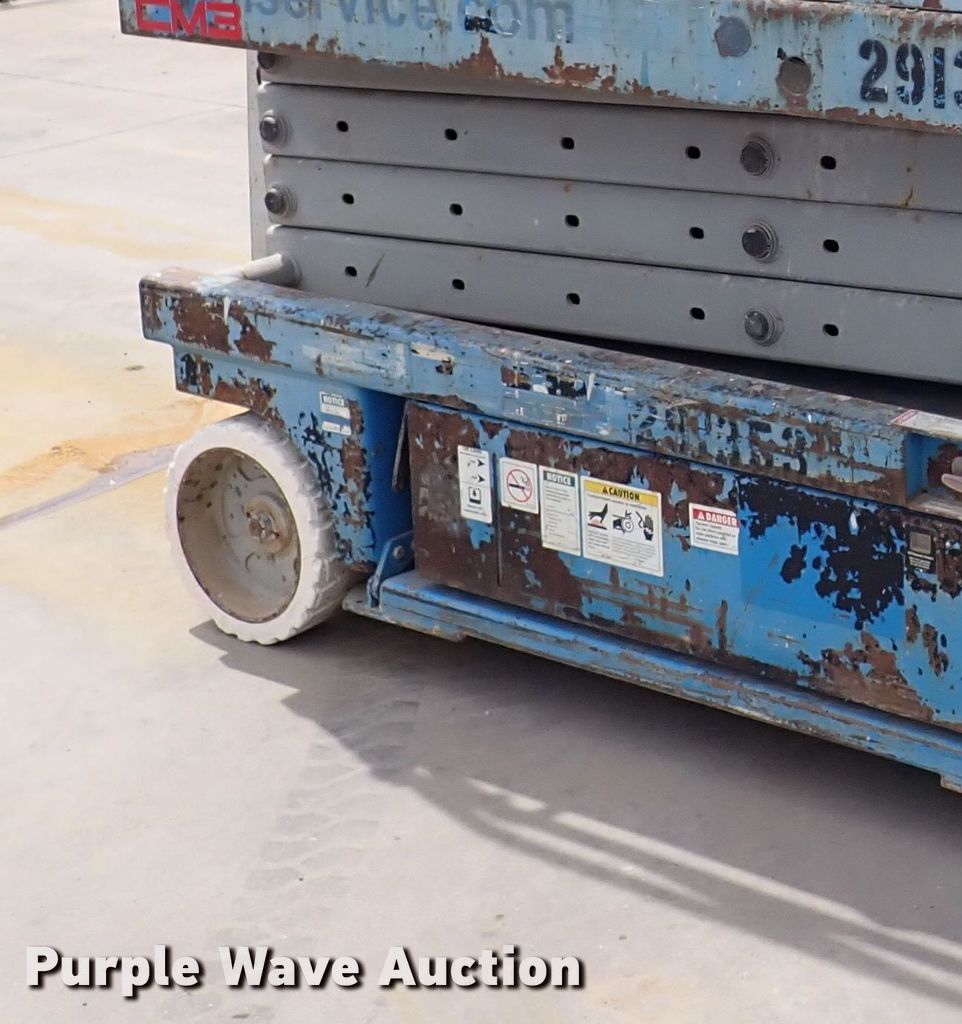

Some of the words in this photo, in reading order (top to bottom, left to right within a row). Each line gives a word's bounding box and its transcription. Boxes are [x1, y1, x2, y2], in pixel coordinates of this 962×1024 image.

[546, 471, 572, 486] NOTICE
[608, 487, 641, 501] CAUTION
[705, 511, 738, 527] DANGER
